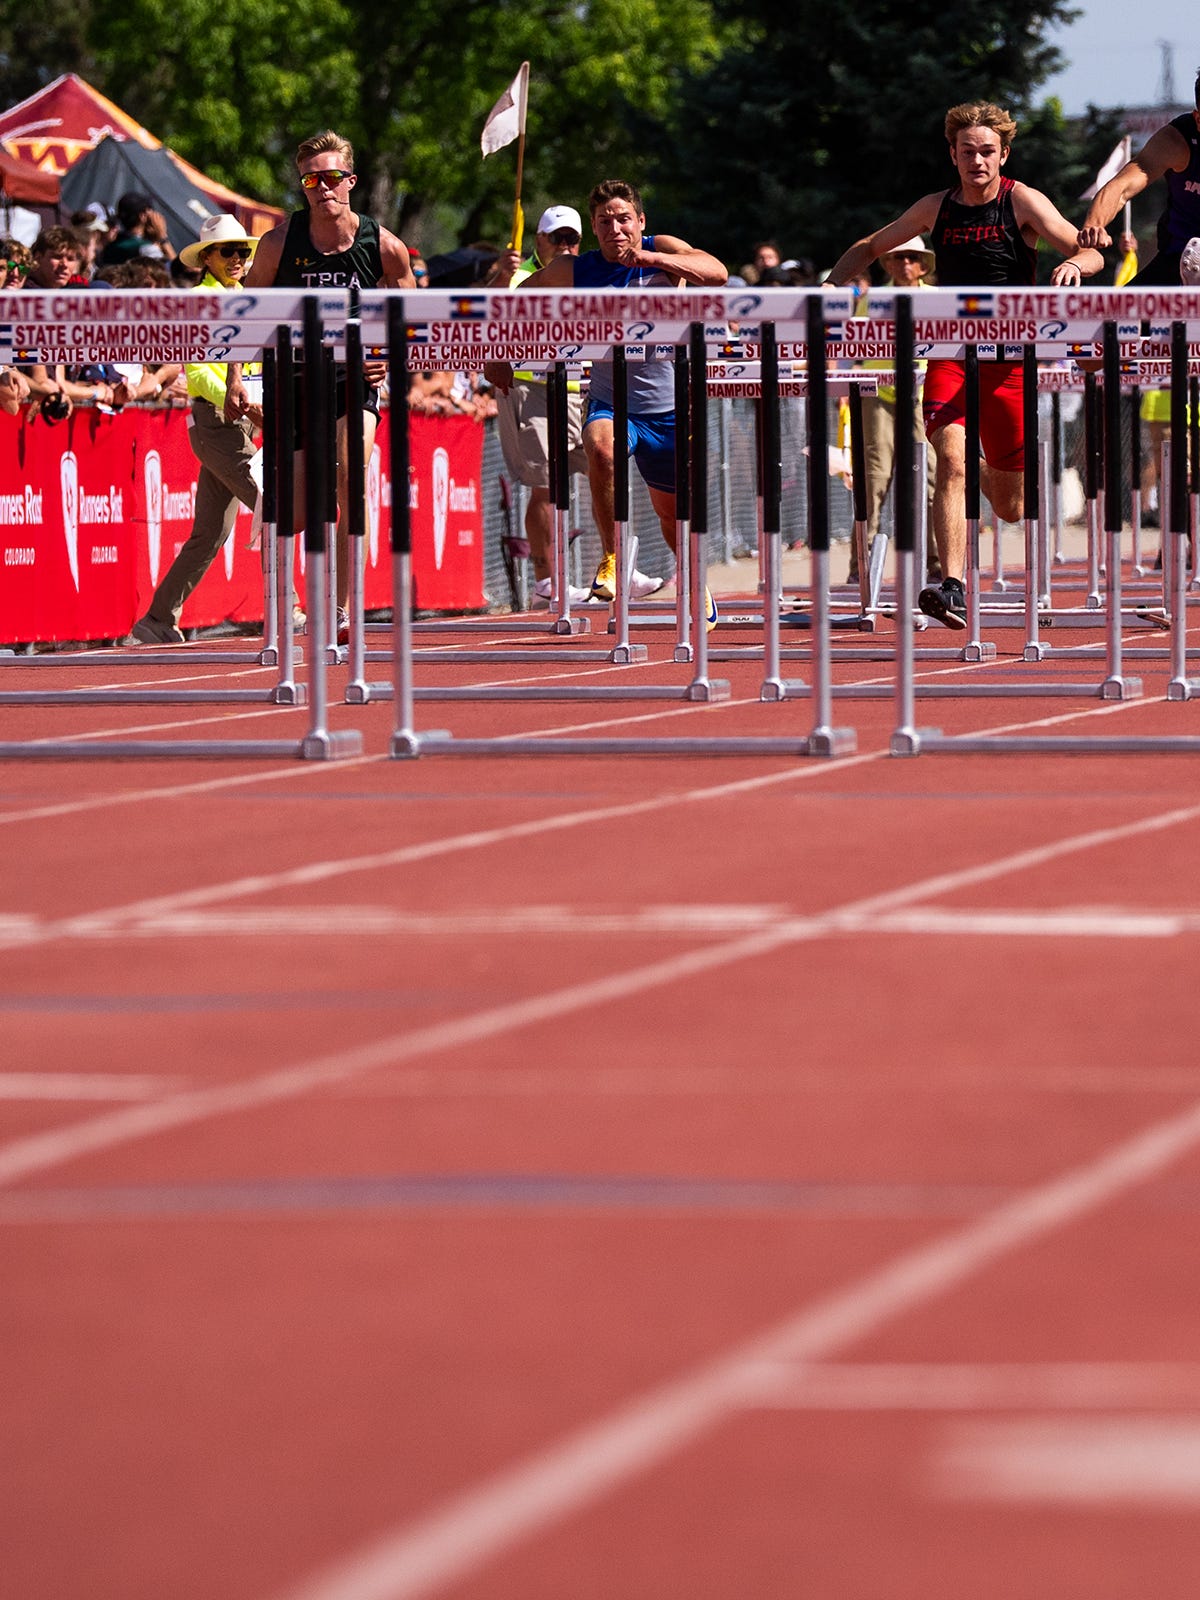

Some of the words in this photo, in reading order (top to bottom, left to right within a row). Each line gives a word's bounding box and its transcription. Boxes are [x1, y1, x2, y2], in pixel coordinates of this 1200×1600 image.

[302, 271, 361, 289] TPCA
[52, 296, 219, 320] CHAMPIONSHIPS
[491, 296, 551, 319] STATE
[560, 296, 724, 319] CHAMPIONSHIPS
[998, 294, 1059, 317] STATE
[15, 324, 66, 344] STATE
[72, 324, 209, 344] CHAMPIONSHIPS
[431, 322, 482, 342] STATE
[488, 321, 624, 342] CHAMPIONSHIPS
[845, 321, 896, 341] STATE
[914, 320, 1037, 340] HAMPIONSHIPS
[40, 347, 83, 361] STATE
[88, 347, 206, 361] CHAMPIONSHIPS
[441, 344, 557, 359] CHAMPIONSHIPS
[1140, 362, 1171, 374] STATE
[5, 547, 36, 566] COLORADO
